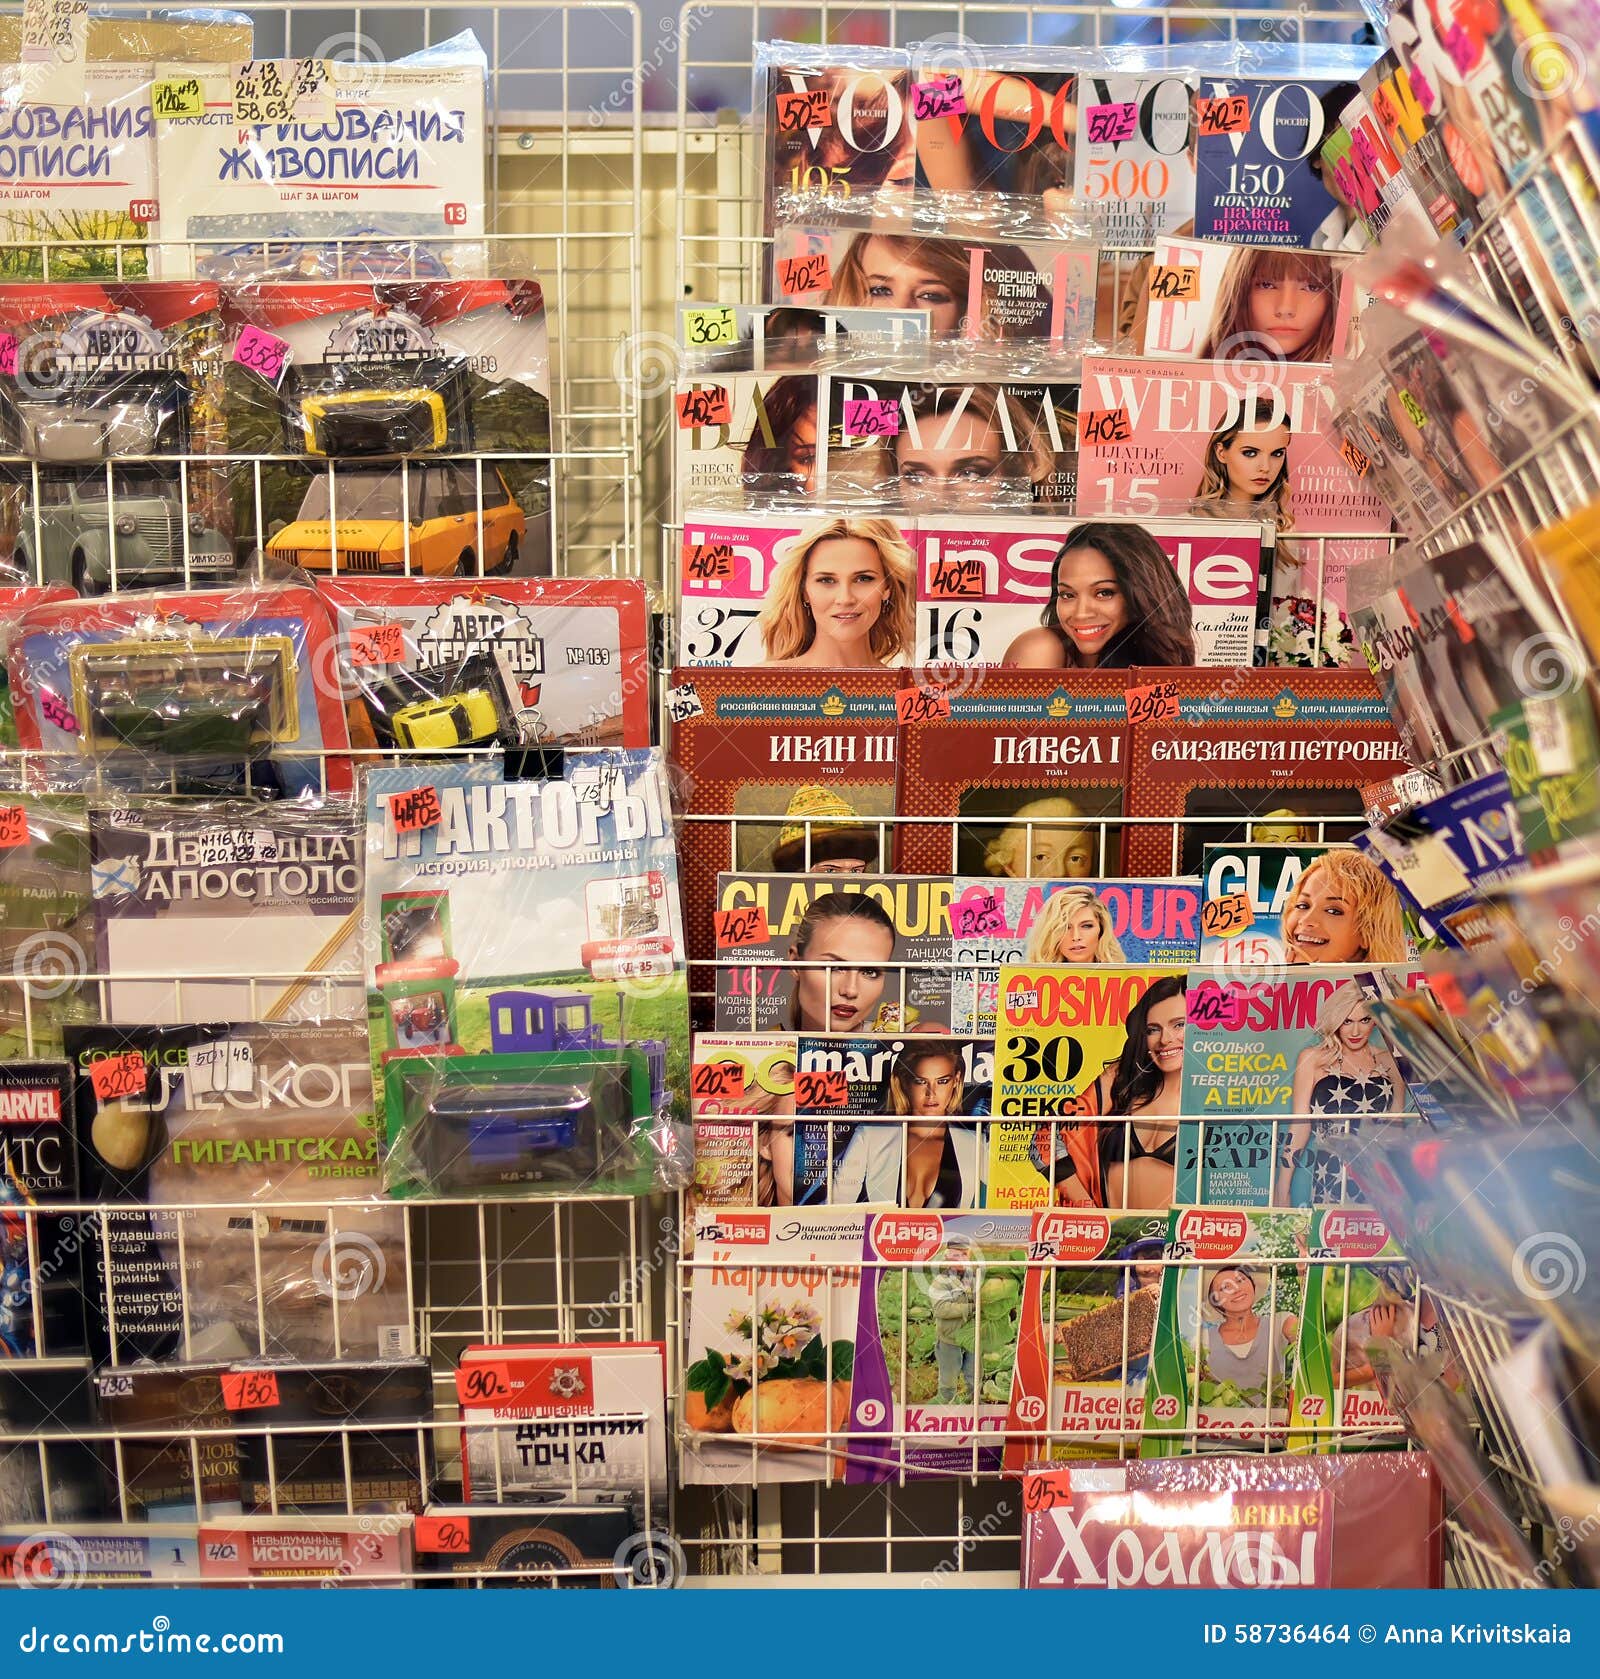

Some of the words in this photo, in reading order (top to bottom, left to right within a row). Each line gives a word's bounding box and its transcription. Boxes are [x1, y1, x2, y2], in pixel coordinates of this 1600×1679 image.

[219, 147, 419, 180] ЖИВОПИСИ
[1084, 159, 1169, 199] 500
[1226, 164, 1284, 195] 150
[13, 190, 50, 198] ШАГОМ
[280, 191, 302, 200] ШАГ
[306, 191, 318, 200] ЗА
[322, 191, 359, 200] ШАГОМ
[1213, 195, 1293, 208] покупок
[132, 204, 157, 218] 103
[447, 207, 466, 221] 13
[1223, 207, 1248, 219] на
[1253, 207, 1280, 219] все
[1212, 220, 1290, 234] времена
[983, 268, 1053, 286] СОВЕРШЕННО
[997, 283, 1038, 299] ЛЕТНИЙ
[1007, 386, 1043, 398] Harper's
[1121, 461, 1184, 475] КАДРЕ
[1093, 478, 1159, 516] 15
[453, 615, 505, 639] АВТО
[687, 607, 762, 659] 37
[925, 607, 982, 660] 16
[1195, 621, 1249, 633] Салдана
[567, 648, 584, 664] №
[586, 648, 609, 665] 169
[720, 702, 780, 711] РОССИЙСКИЕ
[781, 702, 816, 711] КНЯЗЬЯ
[849, 702, 876, 713] ЦАРИ,
[1008, 704, 1042, 713] КНЯЗЬЯ
[1075, 704, 1101, 714] ЦАРИ,
[1234, 705, 1269, 714] КНЯЗЬЯ
[1301, 705, 1328, 715] ЦАРИ,
[769, 735, 858, 763] ИВАН
[864, 735, 896, 763] III
[992, 735, 1101, 764] ПАВЕЛ
[1151, 740, 1288, 761] ЕЛИЗАВЕТА
[415, 855, 496, 876] история,
[561, 849, 638, 865] машины
[731, 949, 776, 957] СЕЗОННОЕ
[1158, 949, 1197, 958] ХОЧЕТСЯ
[1218, 939, 1269, 964] 115
[728, 968, 781, 996] 167
[761, 996, 787, 1006] ИДЕЙ
[726, 1006, 746, 1016] ДЛЯ
[1192, 1040, 1265, 1054] СКОЛЬКО
[1003, 1036, 1083, 1083] 30
[1206, 1054, 1288, 1072] СЕКСА
[15, 1077, 59, 1086] КОМИКСОВ
[1190, 1074, 1226, 1087] ТЕБЕ
[1228, 1074, 1279, 1087] НАДО?
[1001, 1083, 1076, 1096] МУЖСКИХ
[1204, 1088, 1223, 1104] А
[1226, 1087, 1293, 1104] ЕМУ?
[1001, 1097, 1085, 1117] СЕКС-
[1007, 1134, 1030, 1142] НИМ
[173, 1137, 379, 1164] ГИГАНТСКАЯ
[998, 1153, 1010, 1162] НЕ
[1010, 1153, 1044, 1162] ДЕЛАЛ
[1209, 1171, 1252, 1181] НАРЯДЫ,
[1209, 1179, 1254, 1188] МАКИЯЖ,
[995, 1187, 1014, 1199] НА
[1209, 1186, 1225, 1195] КАК
[877, 1222, 937, 1244] Дача
[1045, 1218, 1105, 1242] Дача
[1182, 1215, 1243, 1239] Дача
[1326, 1216, 1386, 1239] Дача
[801, 1231, 839, 1242] дачной
[885, 1247, 930, 1255] КОЛЛЕКЦИЯ
[494, 1406, 538, 1419] ВАДИМ
[863, 1403, 877, 1422] 9
[1020, 1400, 1041, 1418] 16
[1153, 1398, 1177, 1417] 23
[1301, 1398, 1324, 1417] 27
[516, 1442, 606, 1467] ТОЧКА
[252, 1535, 342, 1547] НЕВЫДУМАННЫЕ
[1039, 1506, 1318, 1589] Храмы
[172, 1548, 186, 1566] 1
[252, 1546, 344, 1562] ИСТОРИИ
[371, 1547, 384, 1561] 3
